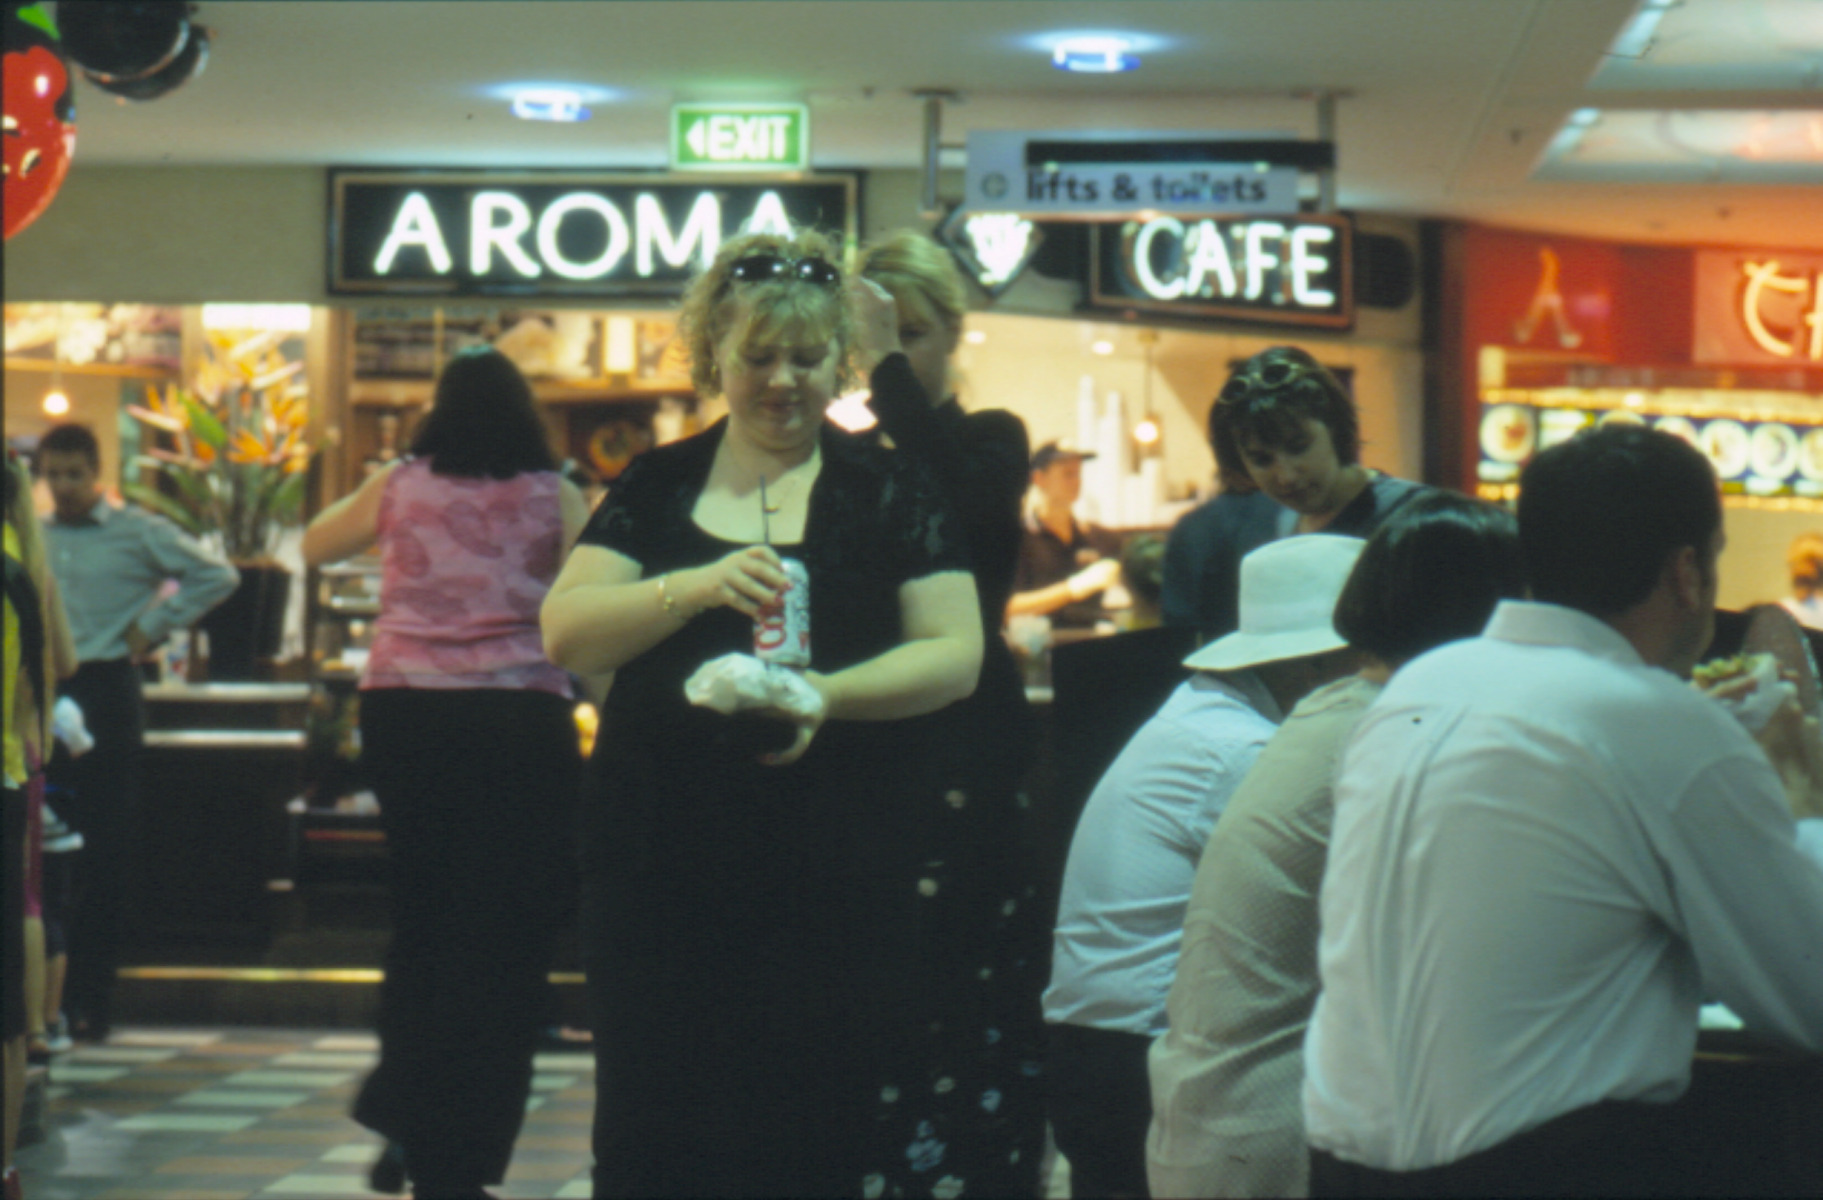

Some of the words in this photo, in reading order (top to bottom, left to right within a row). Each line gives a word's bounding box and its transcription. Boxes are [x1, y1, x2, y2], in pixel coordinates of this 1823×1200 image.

[709, 114, 792, 161] EXIT
[1026, 171, 1098, 202] lifts
[1111, 172, 1138, 202] &
[1152, 170, 1268, 202] toilets
[373, 189, 798, 280] AROMA
[1133, 217, 1336, 307] CAFE
